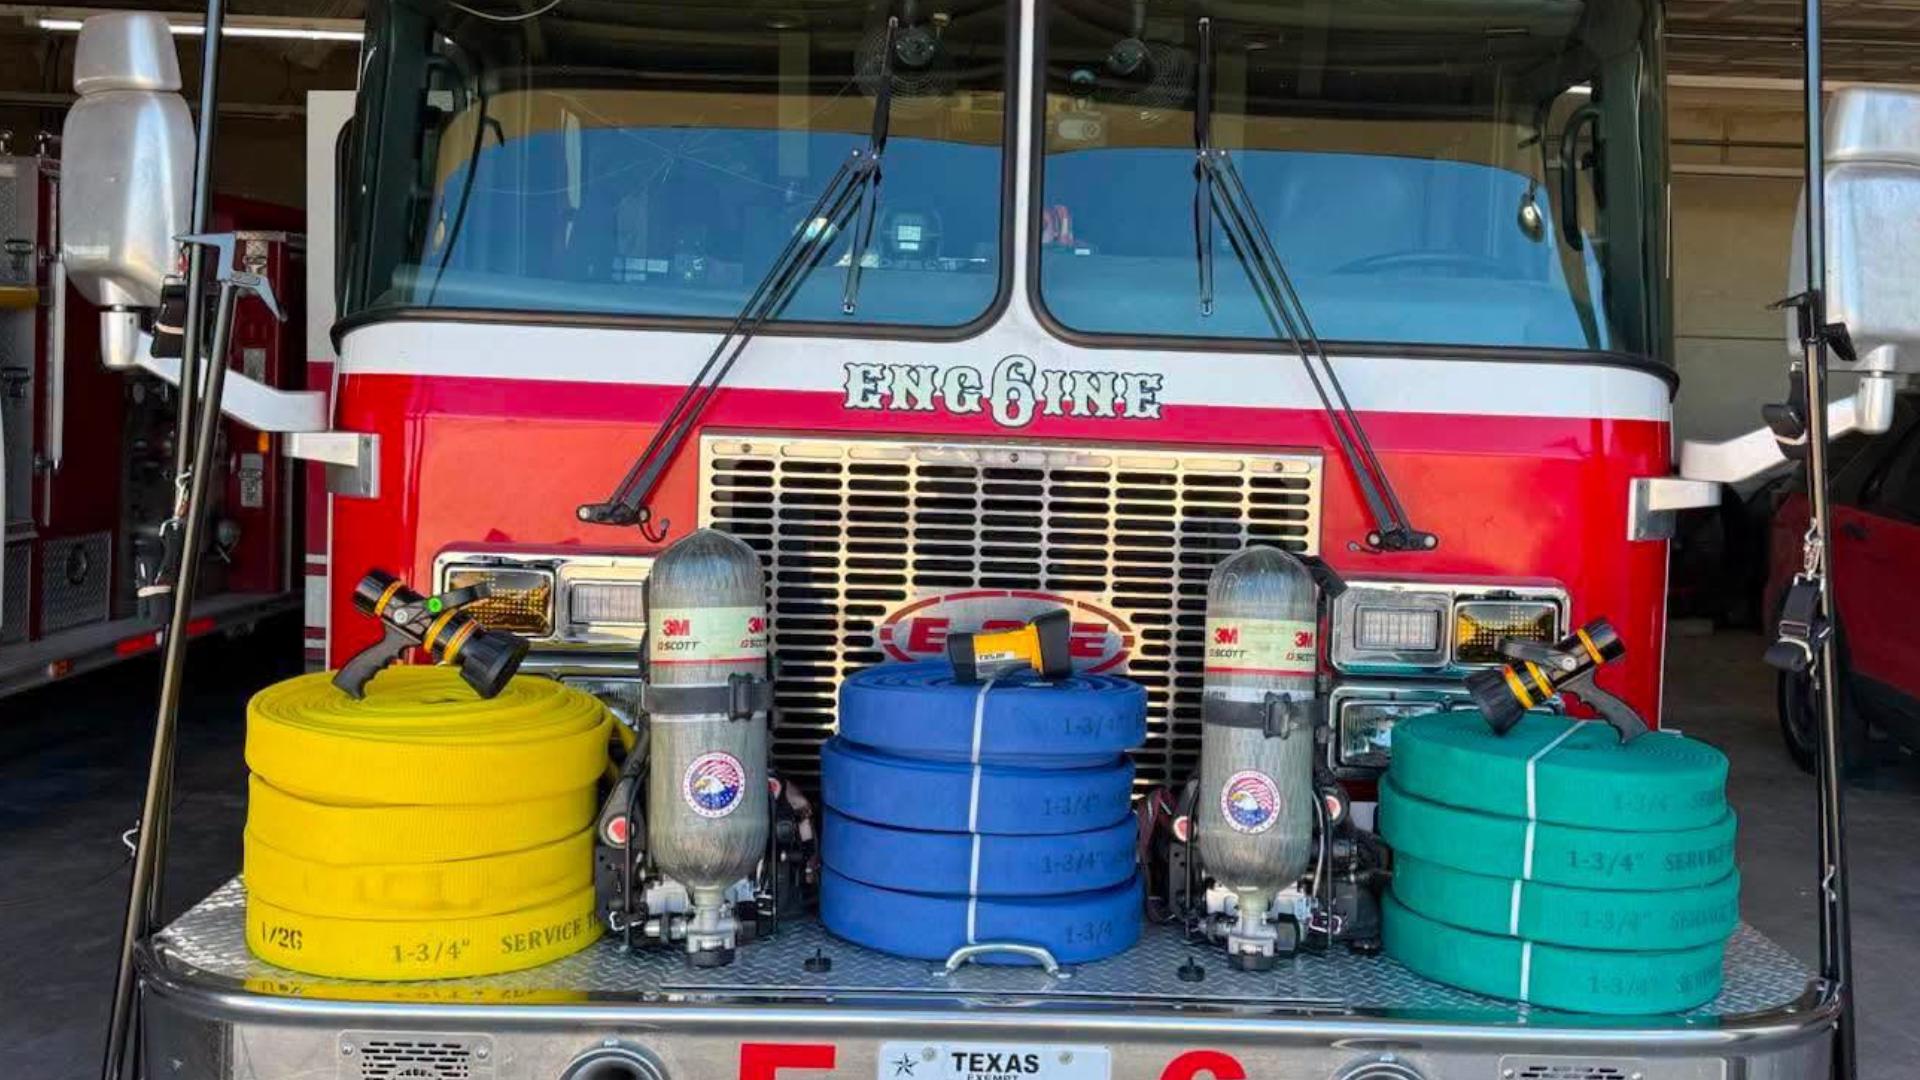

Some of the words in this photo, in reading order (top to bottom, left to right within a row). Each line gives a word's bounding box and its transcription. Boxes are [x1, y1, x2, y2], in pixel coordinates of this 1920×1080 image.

[662, 618, 690, 637] 3M
[1214, 627, 1239, 645] 3M
[1567, 848, 1646, 877] 1-3/4"
[391, 938, 471, 964] 1-3/4"
[501, 918, 581, 953] SERVICE
[951, 1052, 1040, 1073] TEXAS
